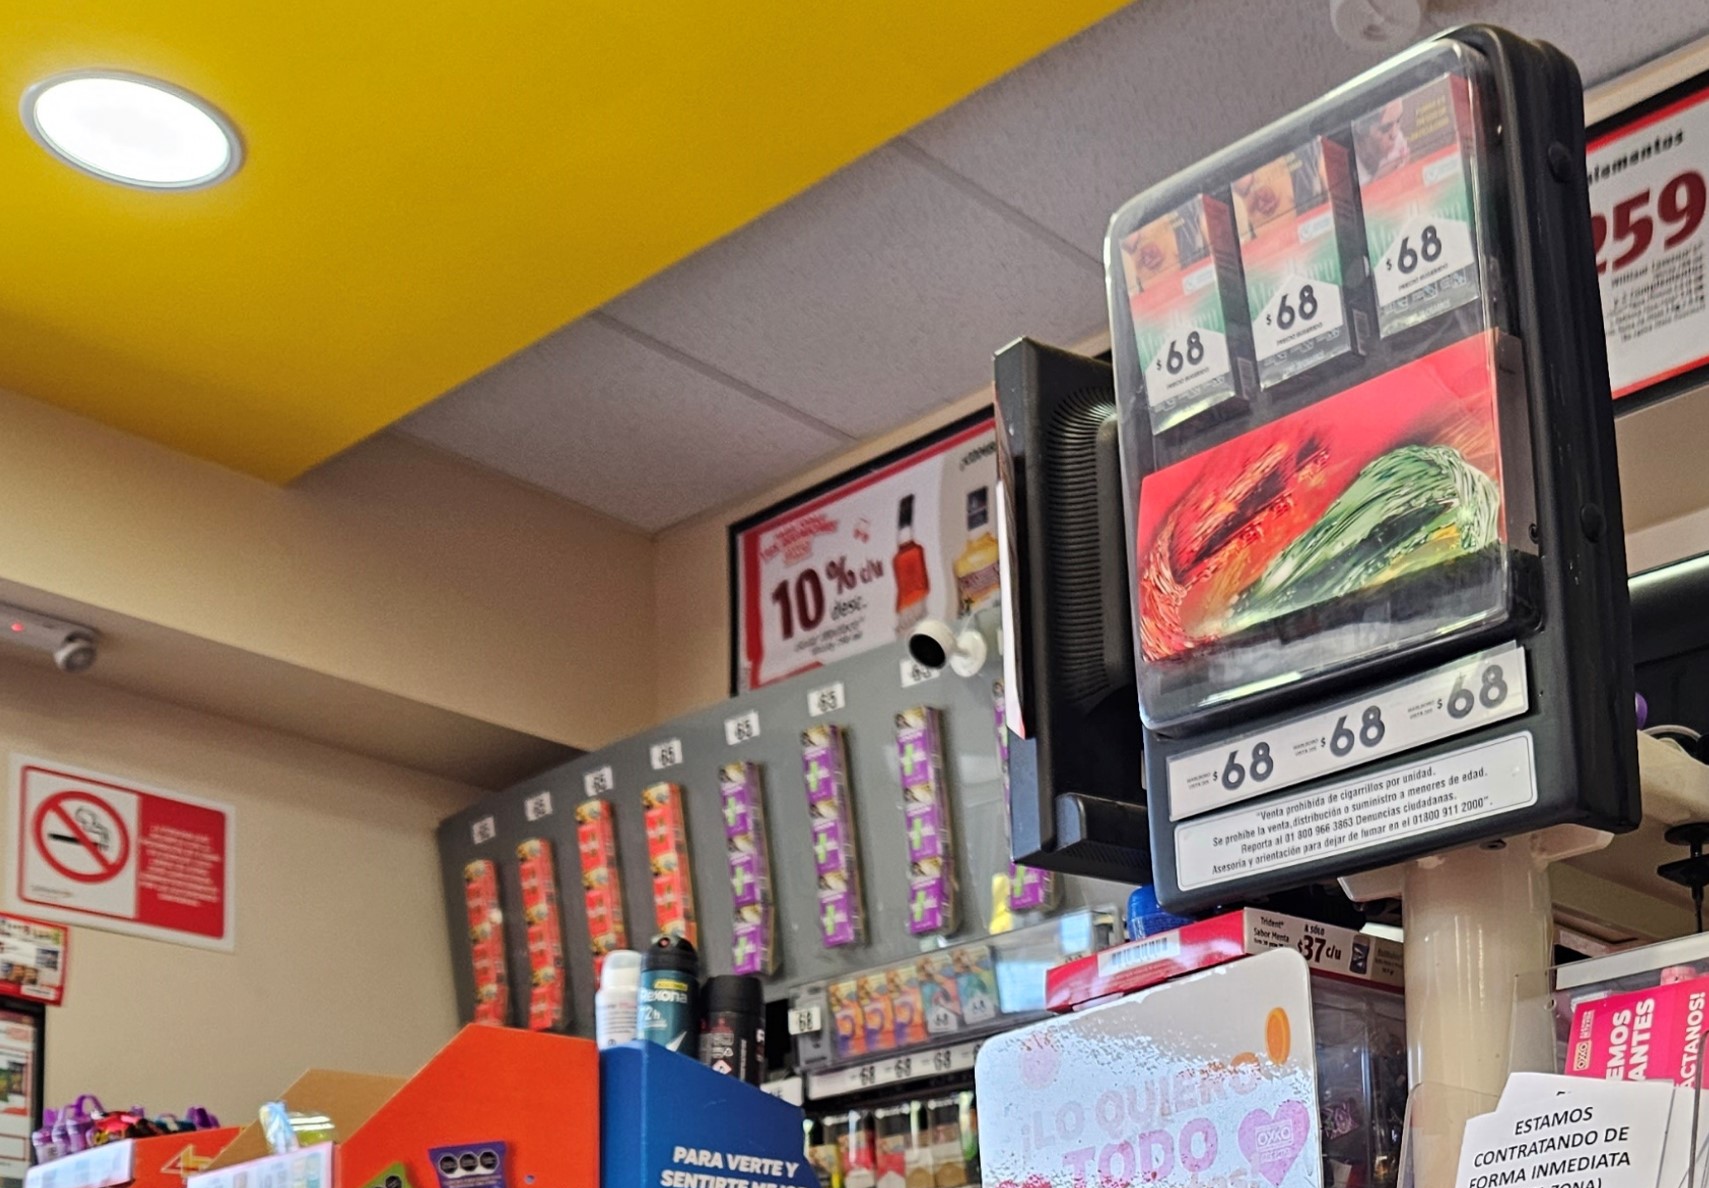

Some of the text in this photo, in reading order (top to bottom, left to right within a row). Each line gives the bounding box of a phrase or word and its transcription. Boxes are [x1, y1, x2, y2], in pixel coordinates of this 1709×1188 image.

[1386, 225, 1442, 274] $68
[1266, 284, 1318, 330] $68
[1156, 331, 1205, 375] $68
[771, 556, 857, 641] 10%
[1436, 665, 1508, 719] $68
[1321, 705, 1386, 758] $68
[1212, 741, 1274, 791] $68
[1286, 766, 1436, 816] prohibida de cigarrillos por unidad.
[1213, 837, 1223, 847] Se
[1225, 828, 1255, 846] prohibe
[1257, 826, 1266, 837] la
[1351, 793, 1397, 812] suministro
[1407, 779, 1446, 796] menores
[1448, 775, 1459, 786] de
[1462, 767, 1488, 782] edad.
[1241, 792, 1457, 854] Reporta al 01 800 966 3863 Denuncias ciudadanas.
[1248, 804, 1459, 867] y orientación para dejar de fumar en el 01800 911
[1605, 1009, 1632, 1080] EMOS
[1628, 998, 1655, 1081] ANTES
[1257, 1124, 1292, 1144] OXXO
[1514, 1106, 1594, 1136] ESTAMOS
[673, 1146, 800, 1178] PARA VERTE Y
[1473, 1126, 1630, 1168] CONTRATANDO DE
[1531, 1151, 1631, 1180] INMEDIATA
